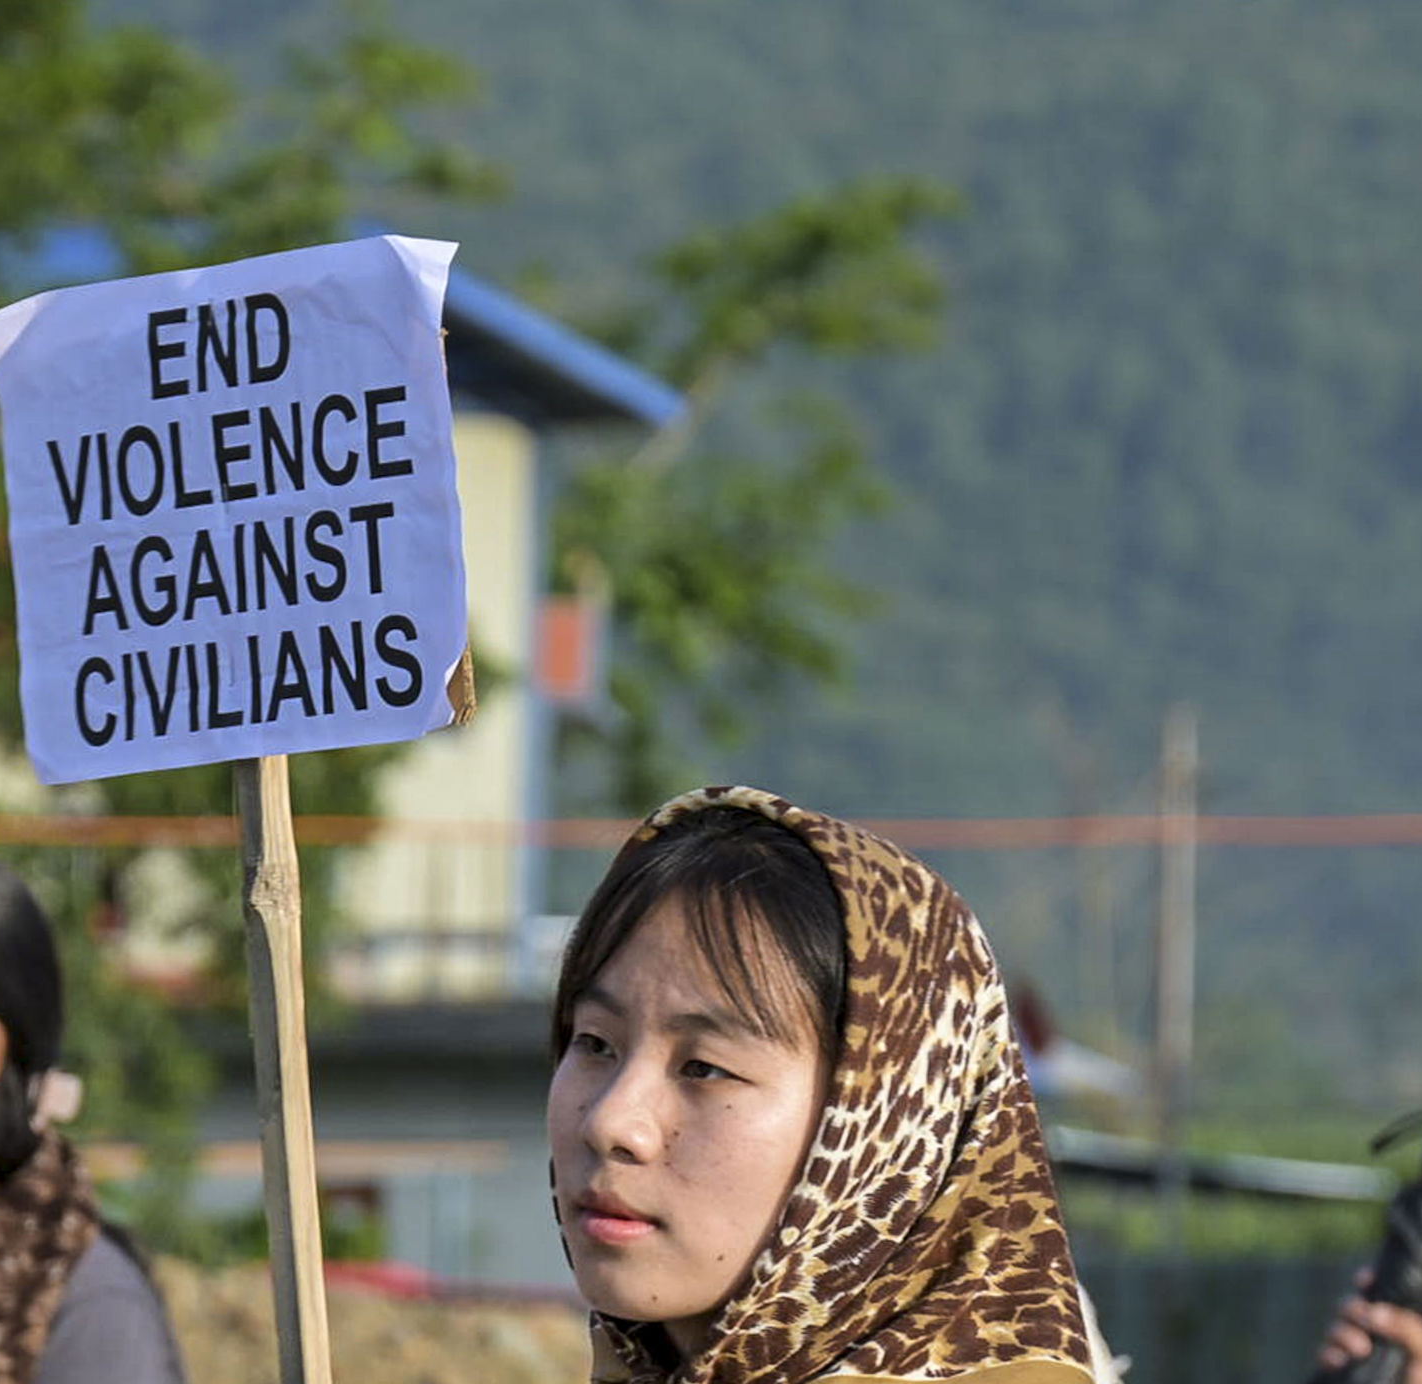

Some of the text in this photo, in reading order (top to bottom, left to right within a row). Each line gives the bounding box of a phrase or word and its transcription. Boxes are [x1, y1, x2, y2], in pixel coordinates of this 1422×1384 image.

[148, 292, 291, 400] END
[46, 385, 414, 526] VIOLENCE
[82, 501, 395, 636] AGAINST
[74, 614, 423, 747] CIVILIANS
